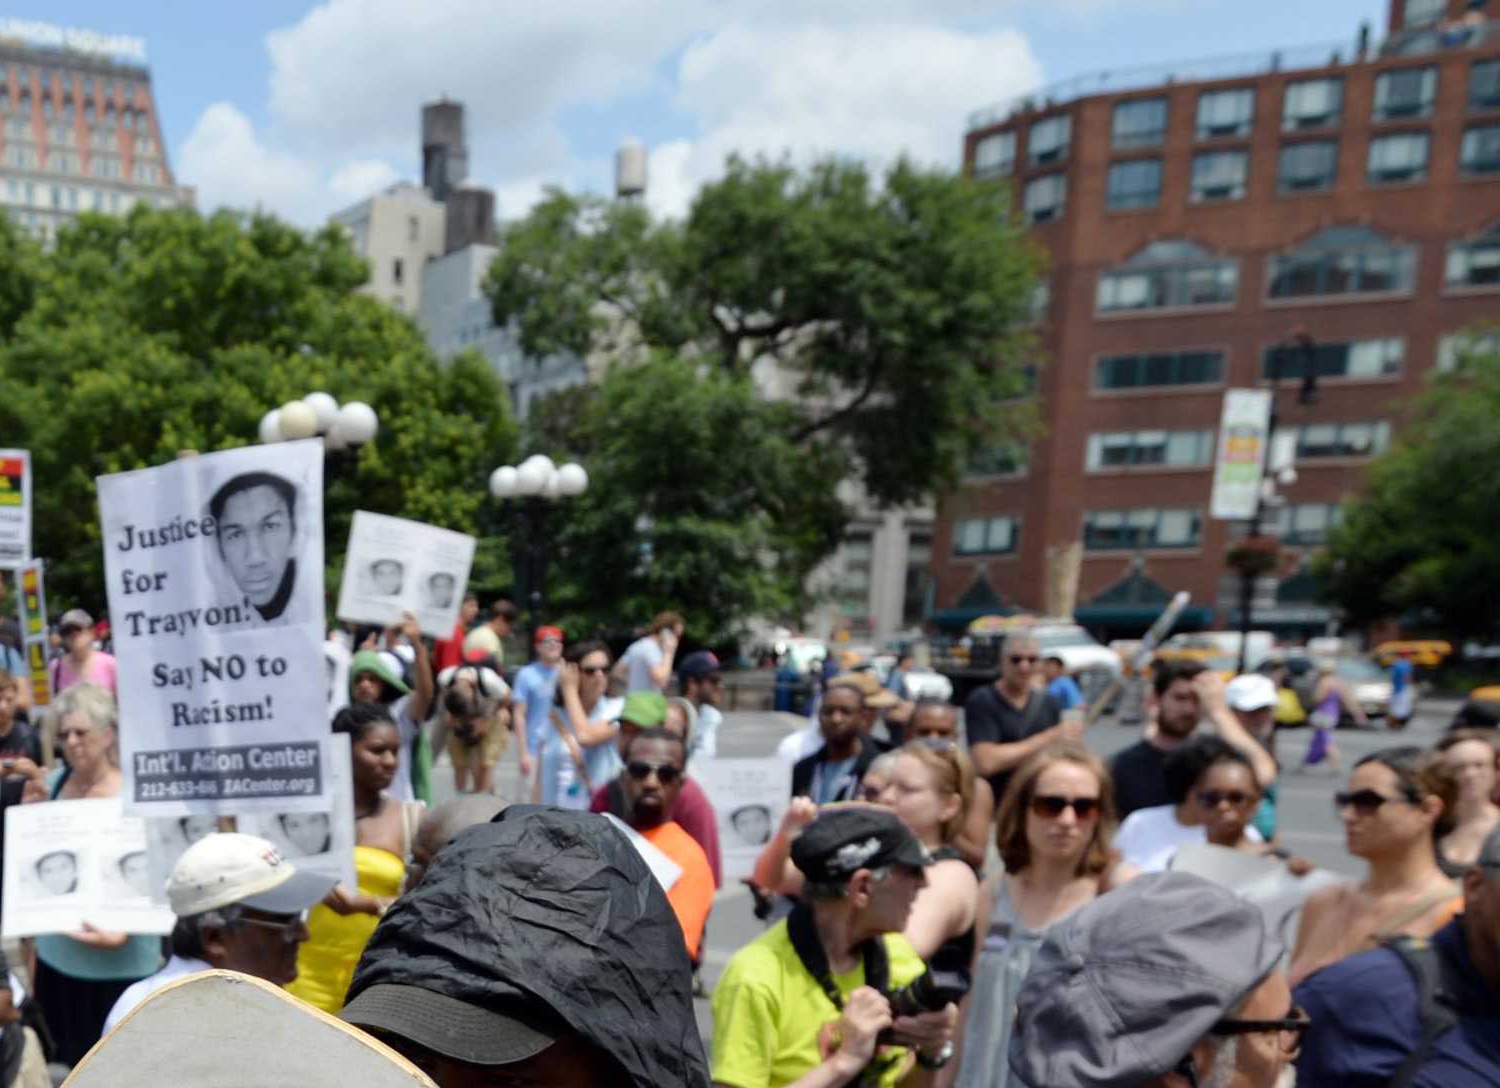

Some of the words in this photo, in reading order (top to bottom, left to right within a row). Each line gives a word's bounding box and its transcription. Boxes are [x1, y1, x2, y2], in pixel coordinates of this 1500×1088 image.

[118, 514, 216, 552] Justice
[121, 568, 168, 595] for
[125, 597, 251, 637] Trayvon!
[153, 662, 194, 690] Say
[201, 655, 246, 682] NO
[256, 654, 288, 678] to
[172, 695, 274, 727] Racism!
[136, 753, 187, 776] Int'l.
[250, 747, 317, 769] Center
